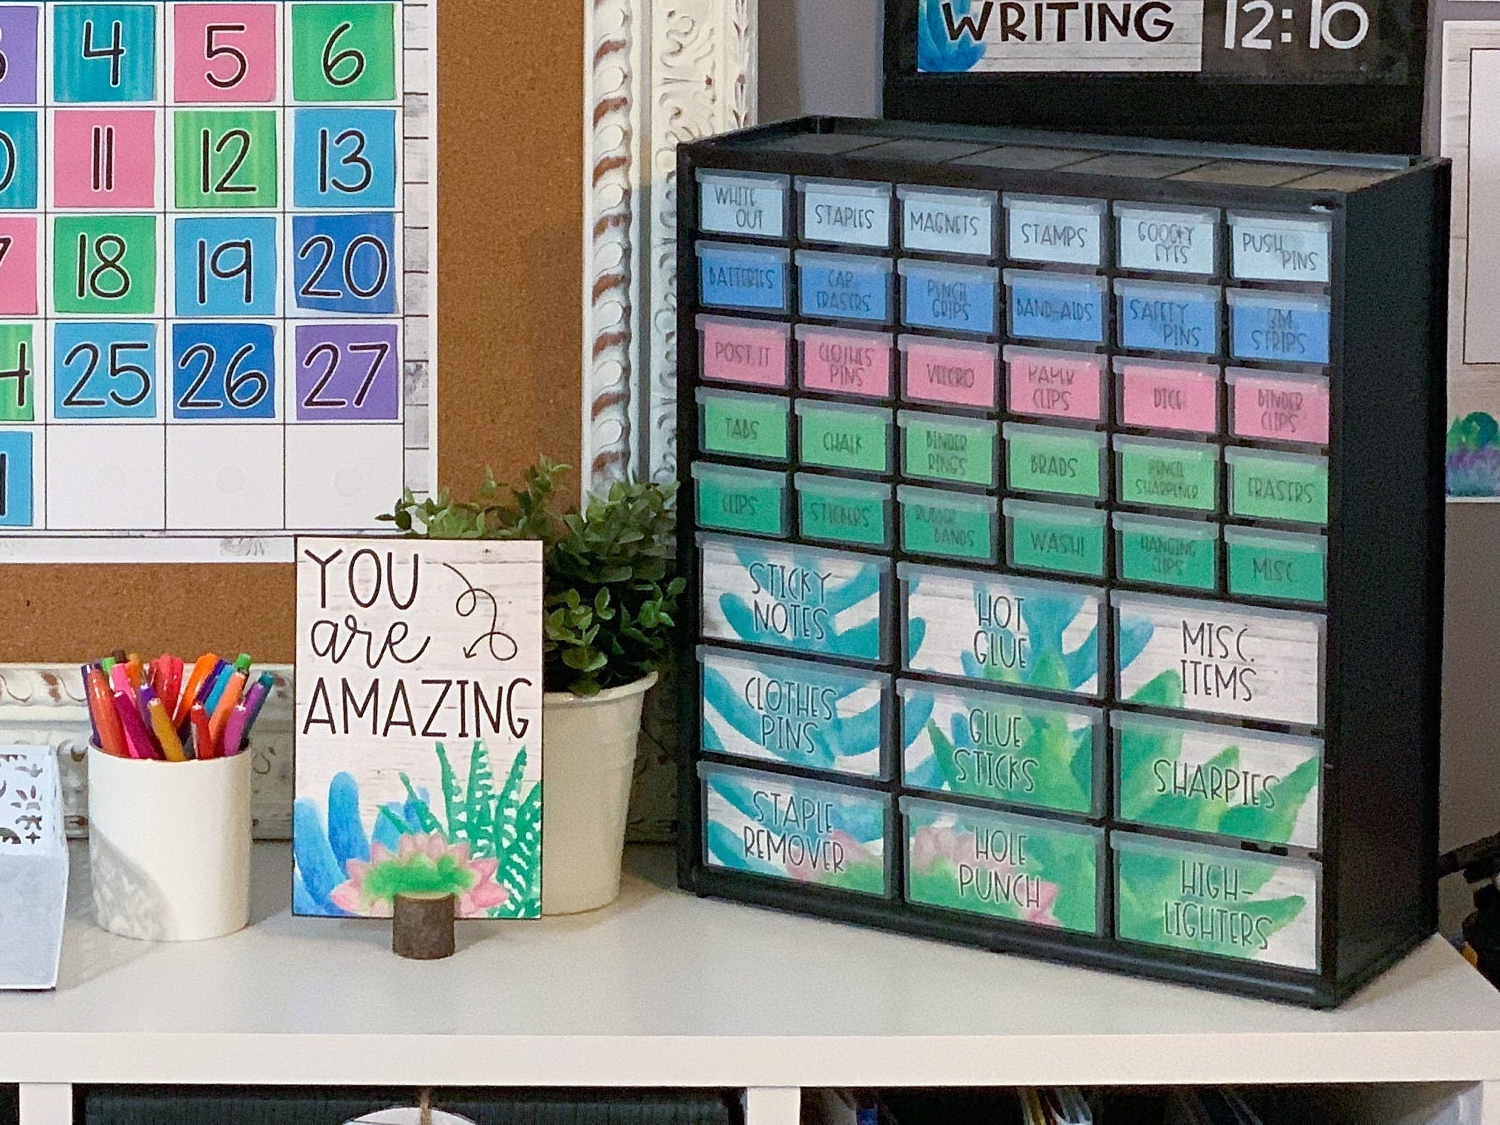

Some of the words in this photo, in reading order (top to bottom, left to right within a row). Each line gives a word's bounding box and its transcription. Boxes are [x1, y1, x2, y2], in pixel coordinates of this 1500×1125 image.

[942, 1, 1175, 43] WRITING
[1224, 0, 1369, 50] 12:10
[82, 21, 125, 86] 4
[204, 23, 248, 88] 5
[322, 22, 365, 86] 6
[92, 126, 114, 191] 11
[201, 128, 258, 194] 12
[318, 129, 373, 193] 13
[736, 208, 764, 230] OUT
[815, 204, 875, 230] STAPLES
[910, 211, 980, 236] MAGNETS
[1021, 223, 1088, 248] STAMPS
[1155, 243, 1190, 264] EYES
[1242, 232, 1283, 253] PUSH
[1282, 250, 1318, 271] PINS
[76, 233, 130, 299] 18
[198, 238, 252, 304] 19
[299, 234, 389, 298] 20
[1163, 325, 1201, 348] PINS
[63, 342, 151, 407] 25
[177, 343, 268, 408] 26
[303, 343, 390, 408] 27
[725, 416, 759, 441] TABS
[823, 432, 864, 455] CHALK
[1030, 456, 1078, 478] BRADS
[1248, 476, 1315, 504] ERASERS
[303, 548, 419, 610] YOU
[749, 563, 832, 602] STICKY
[753, 600, 829, 641] NOTES
[977, 593, 1025, 632] HOT
[311, 614, 431, 669] are
[973, 630, 1027, 670] GLUE
[1182, 619, 1255, 663] MISC.
[744, 676, 838, 721] CLOTHES
[1180, 659, 1257, 703] ITEMS
[303, 677, 533, 739] AMAZING
[969, 707, 1023, 748] GLUE
[761, 717, 821, 754] PINS
[953, 748, 1039, 793] STICKS
[1153, 759, 1281, 810] SHARPIES
[752, 790, 834, 834] STAPLE
[744, 825, 844, 873] REMOVER
[975, 827, 1027, 865] HOLE
[958, 863, 1041, 909] PUNCH
[1180, 859, 1255, 902] HIGH-
[1163, 902, 1274, 951] LIGHTERS
